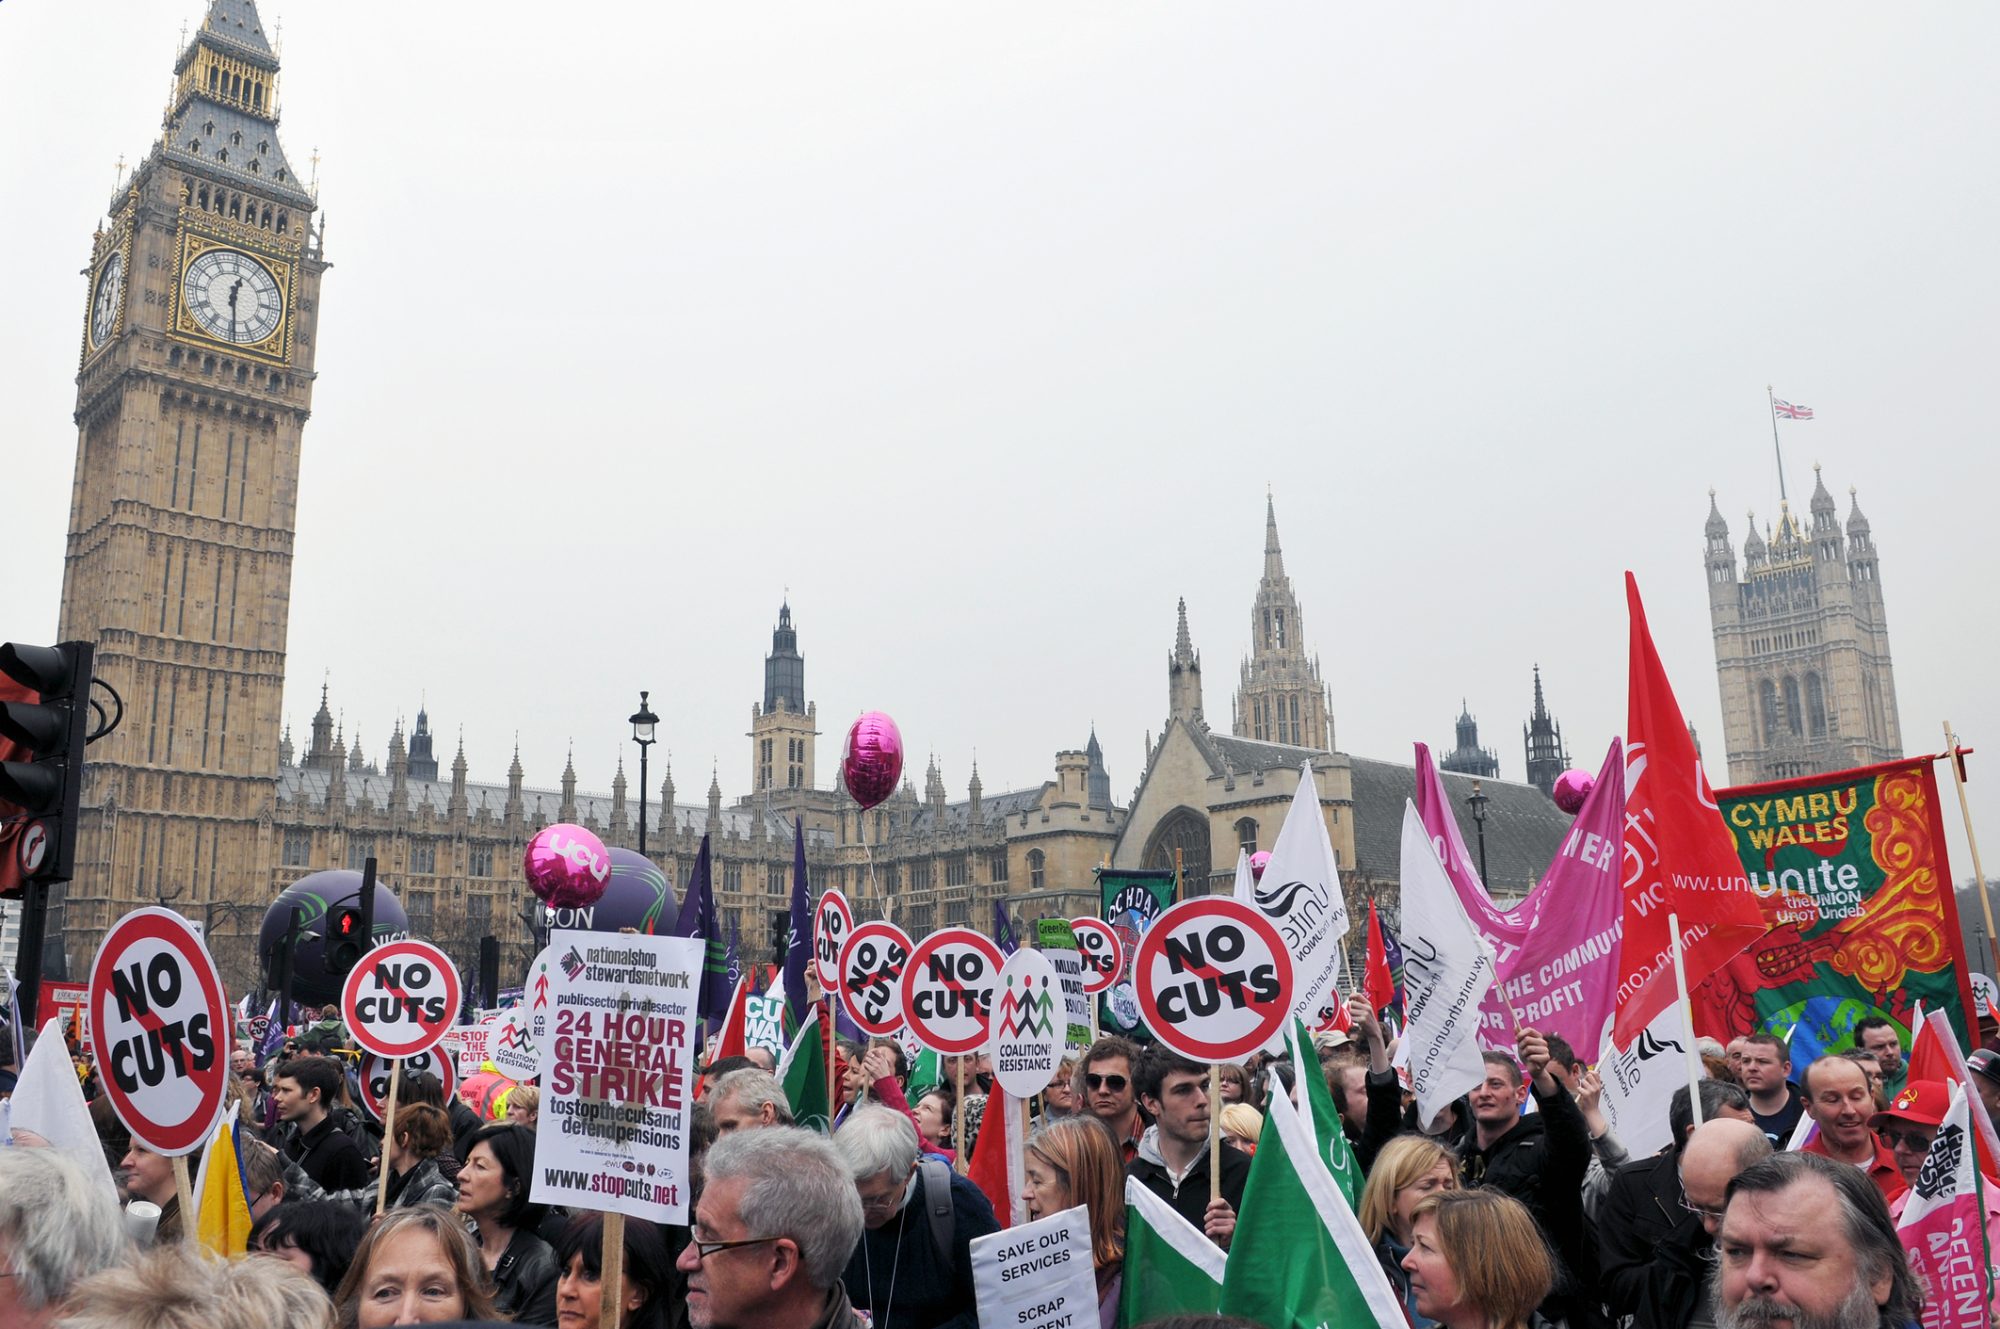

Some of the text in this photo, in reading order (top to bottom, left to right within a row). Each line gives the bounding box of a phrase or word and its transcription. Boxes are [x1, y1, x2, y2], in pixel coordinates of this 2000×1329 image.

[1731, 787, 1858, 828] CYMRU
[1748, 816, 1849, 849] WALES
[822, 909, 842, 935] NO
[1819, 903, 1866, 919] Undeb
[818, 937, 842, 964] CUT
[1164, 925, 1245, 974] NO
[374, 963, 431, 990] NO
[847, 943, 877, 997] NO
[929, 953, 984, 982] NO
[112, 952, 182, 1023] NO
[865, 943, 907, 1025] CUTS
[1156, 964, 1281, 1024] CUTS
[1492, 975, 1539, 1003] THE
[355, 997, 445, 1024] CUTS
[745, 996, 783, 1022] CU
[913, 988, 994, 1019] CUTS
[1514, 980, 1584, 1028] PROFIT
[555, 1009, 592, 1037] 24
[603, 1012, 685, 1048] HOUR
[745, 1018, 783, 1043] WA
[111, 1013, 215, 1094] CUTS
[460, 1051, 490, 1062] CUTS
[465, 1041, 486, 1052] THE
[498, 1048, 535, 1064] COALITION
[554, 1036, 683, 1075] GENERAL
[1000, 1043, 1048, 1057] COALITION
[496, 1056, 537, 1072] RESISTANCE
[999, 1058, 1051, 1072] RESISTANCE
[551, 1061, 683, 1110] STRIKE
[545, 1168, 679, 1206] www.stopcuts.net
[997, 1229, 1070, 1262] SAVE OUR
[1001, 1249, 1071, 1282] SERVICES
[1018, 1297, 1065, 1323] SCRAP
